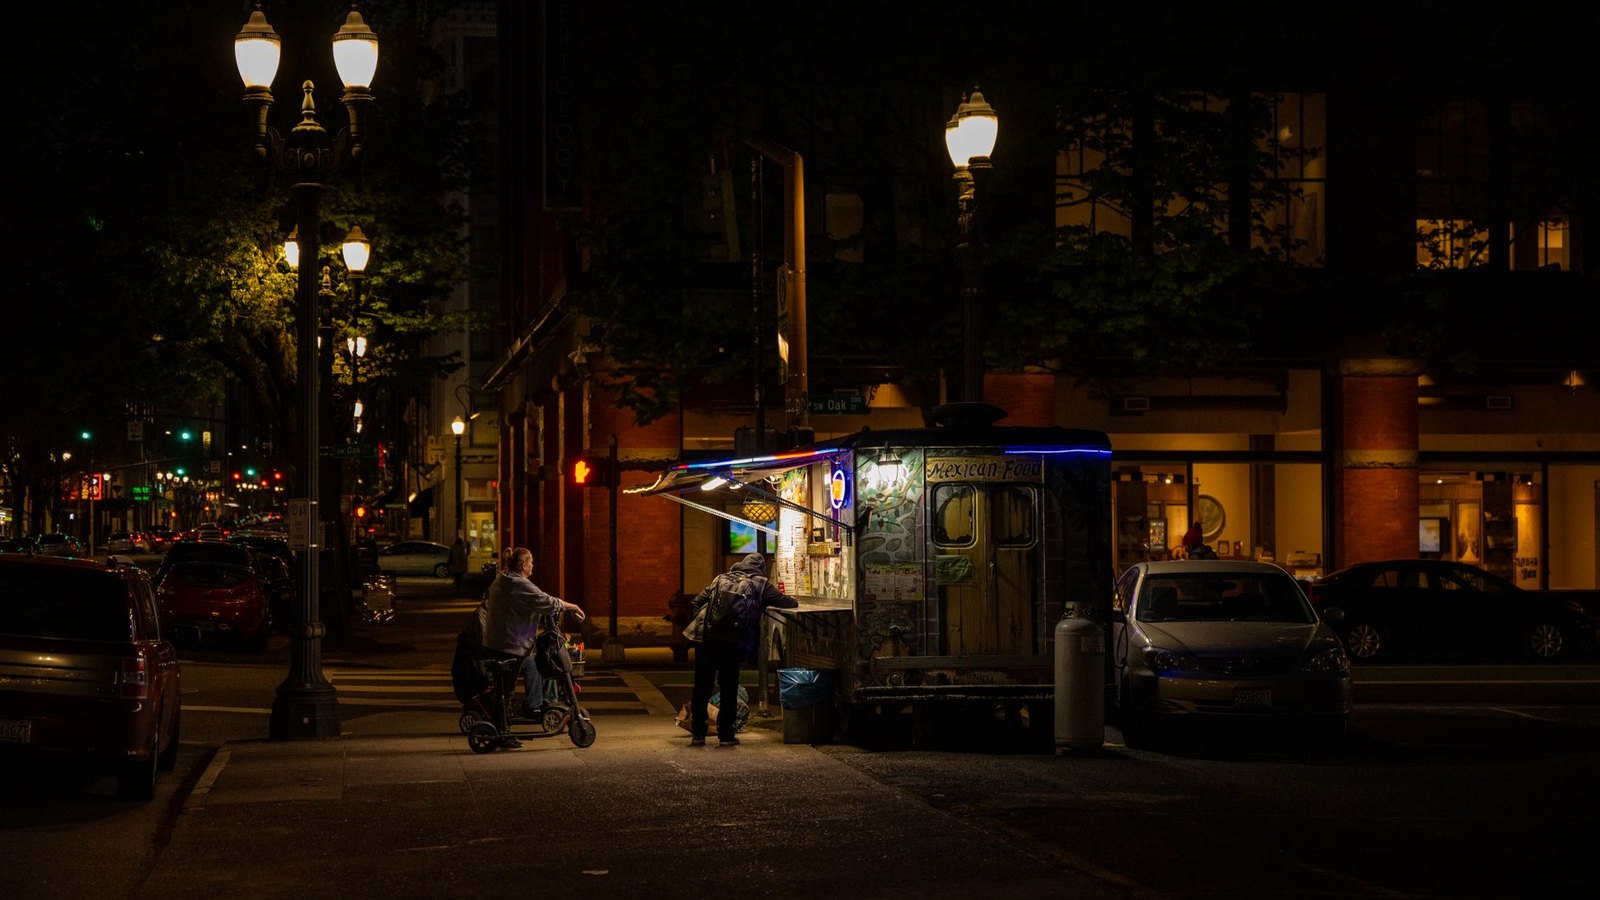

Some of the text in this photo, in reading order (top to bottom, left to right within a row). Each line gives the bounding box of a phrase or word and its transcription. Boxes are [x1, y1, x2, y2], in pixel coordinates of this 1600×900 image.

[827, 399, 847, 410] Oak
[927, 460, 1041, 480] Mexican Food
